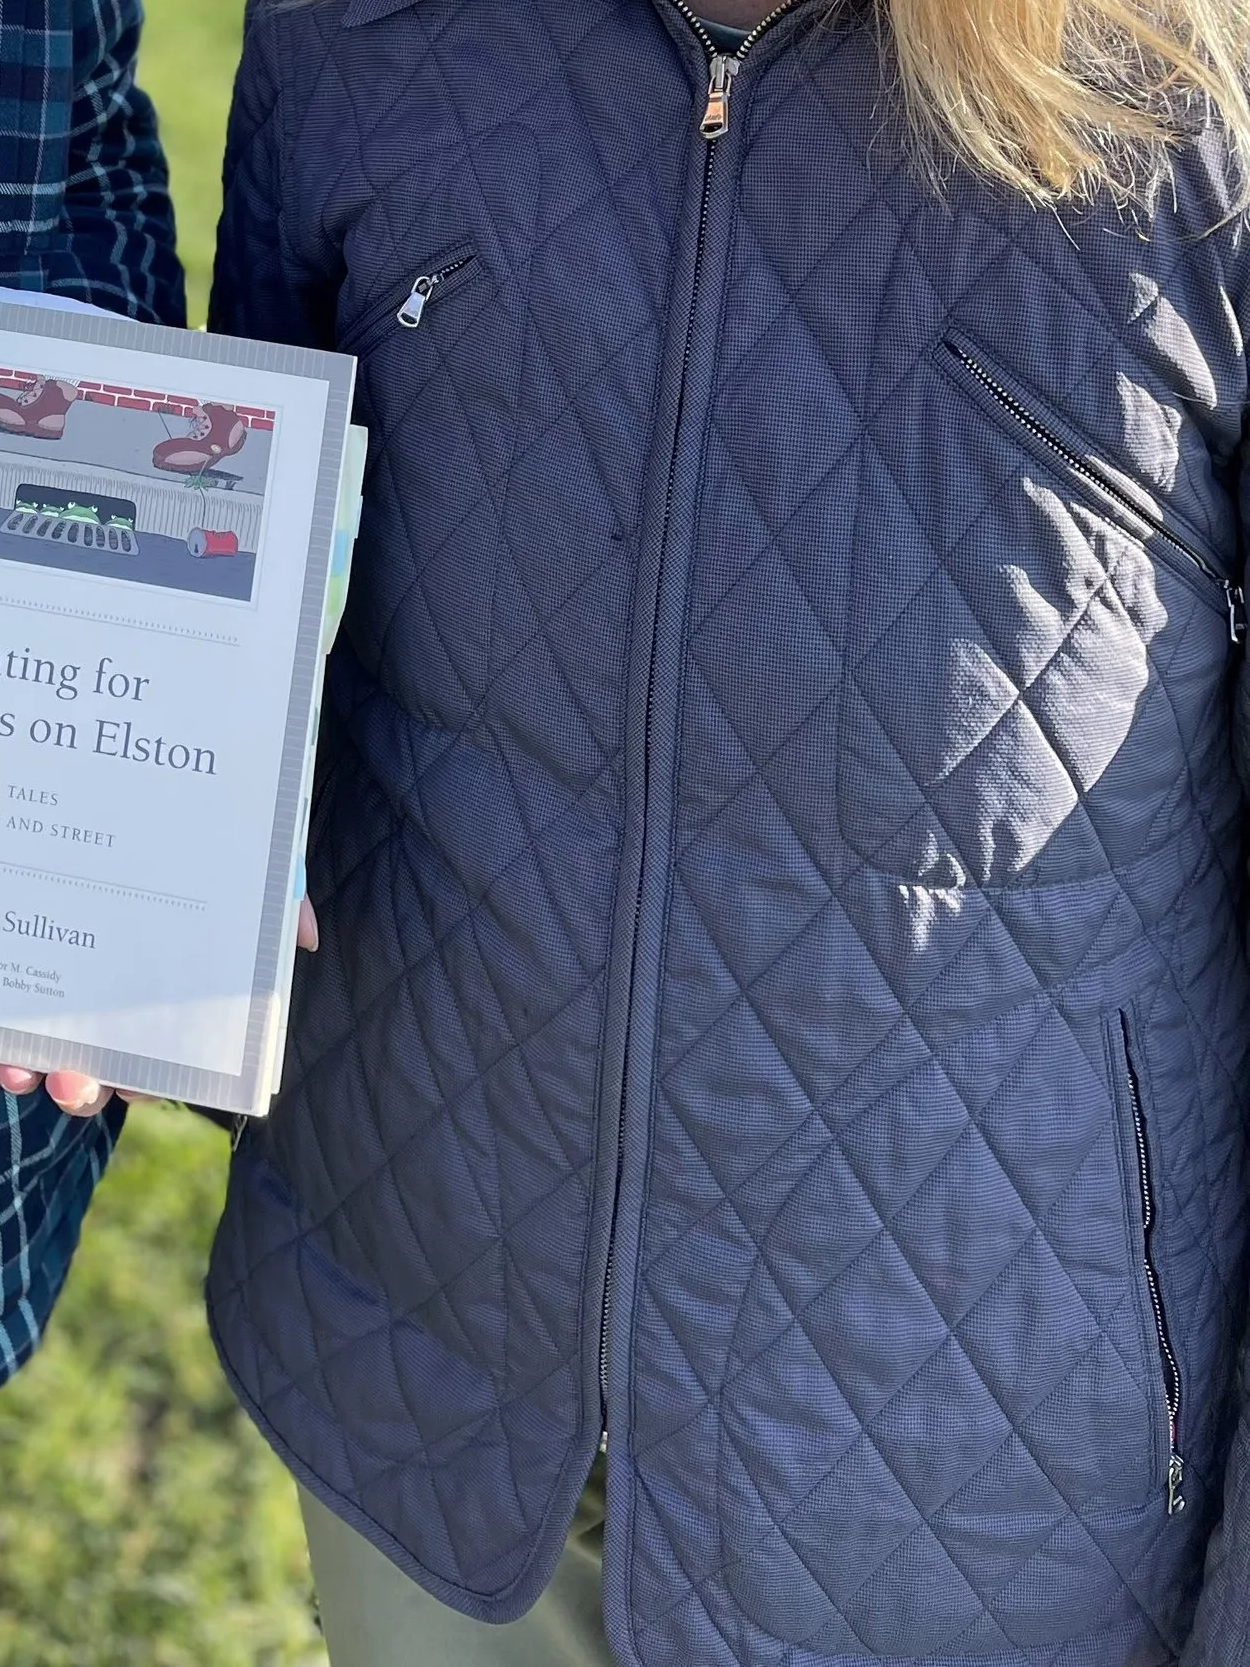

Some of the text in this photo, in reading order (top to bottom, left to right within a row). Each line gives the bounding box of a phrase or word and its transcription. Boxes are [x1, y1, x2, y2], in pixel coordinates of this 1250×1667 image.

[92, 656, 150, 701] for
[29, 718, 78, 750] on
[92, 719, 217, 775] Elston
[7, 784, 59, 806] TALES
[6, 816, 44, 834] AND
[50, 824, 116, 848] STREET
[2, 910, 96, 949] Sullivan
[2, 977, 32, 993] Bobby
[34, 982, 65, 998] Sutton
[10, 962, 22, 974] M.
[25, 965, 62, 984] Cassidy
